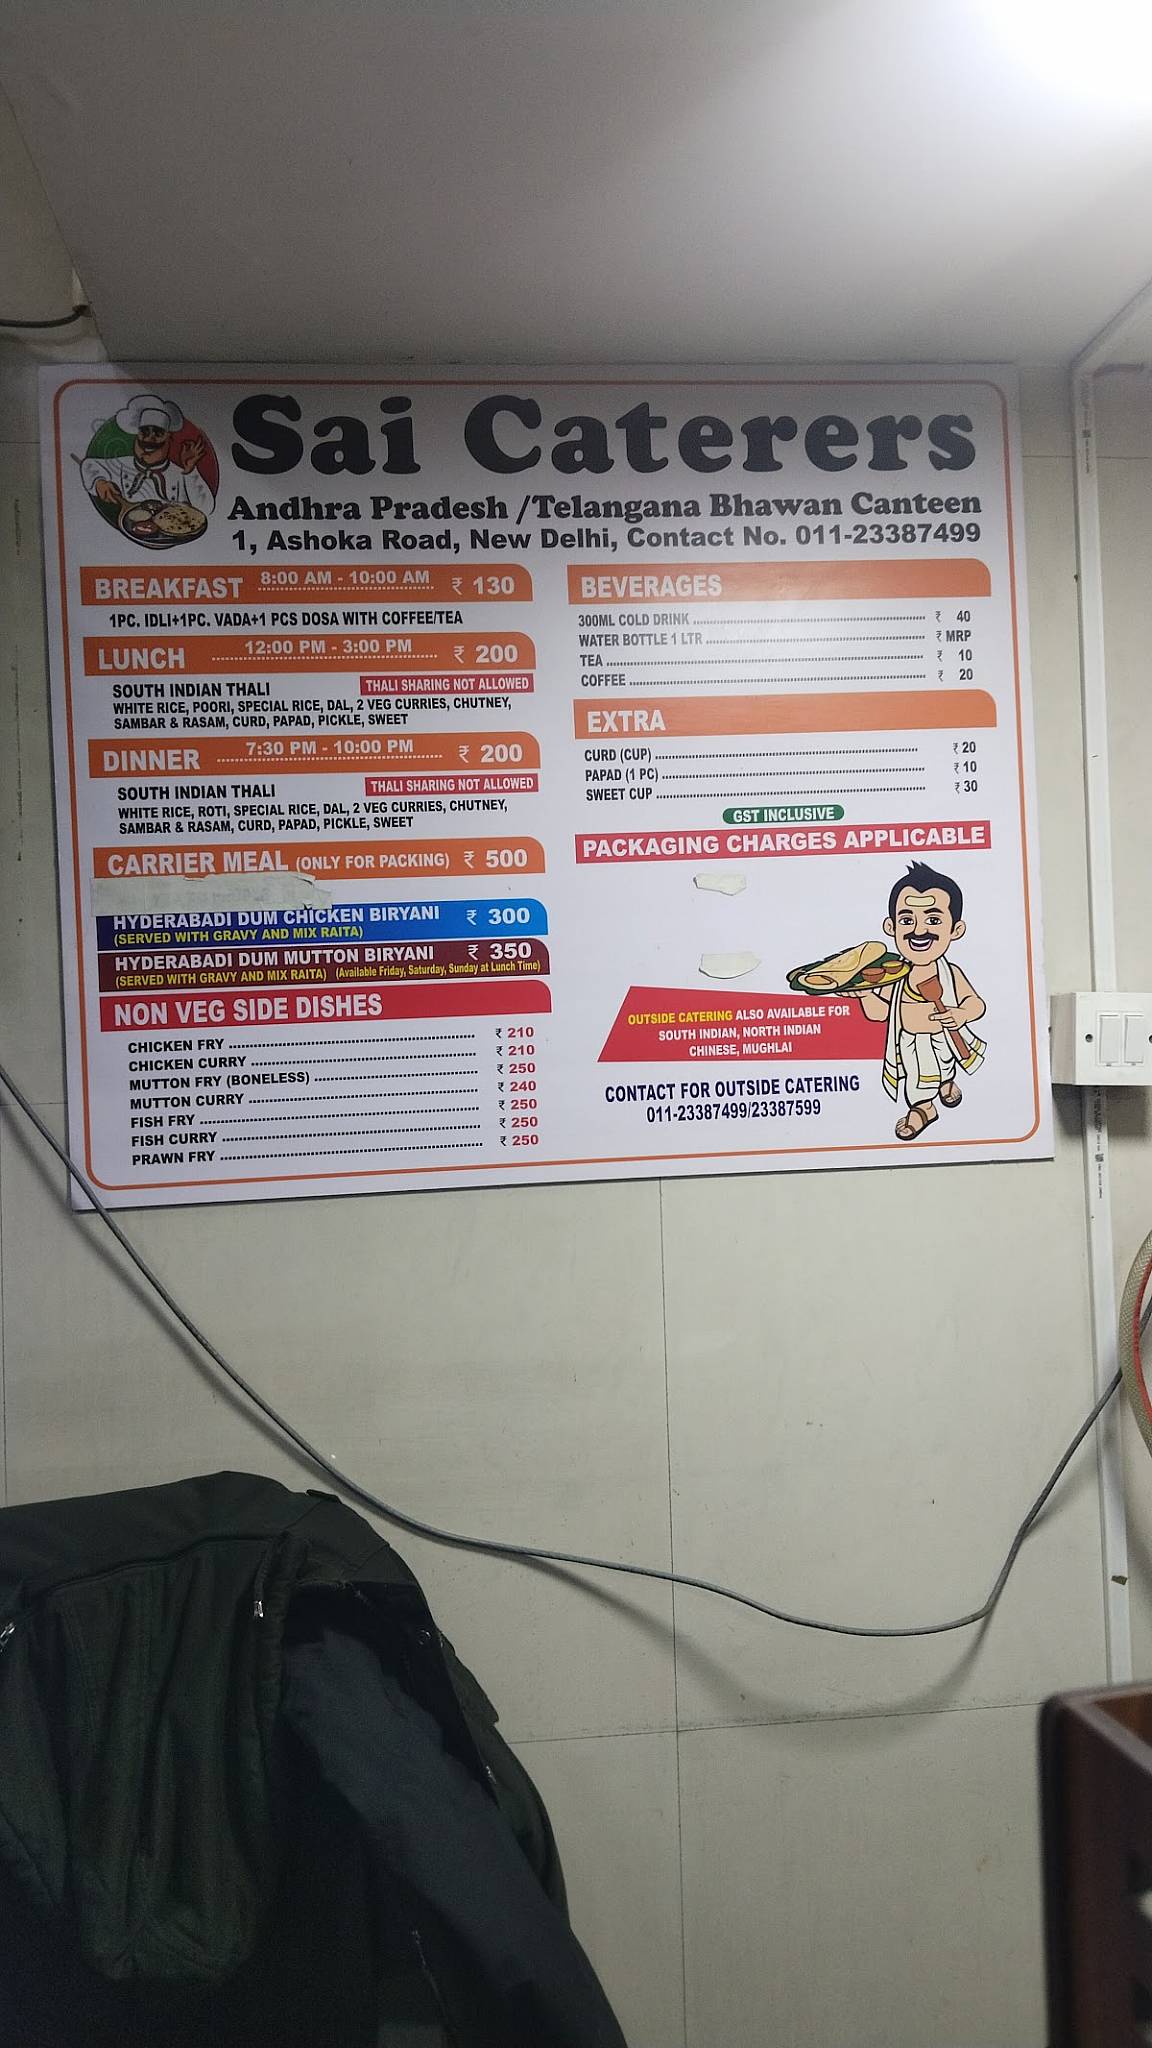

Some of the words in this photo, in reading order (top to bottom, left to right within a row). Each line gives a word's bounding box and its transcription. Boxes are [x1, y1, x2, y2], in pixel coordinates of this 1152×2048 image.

[231, 394, 421, 475] Sai
[464, 395, 976, 474] Caterers
[227, 495, 361, 520] Andhra
[370, 495, 508, 520] Pradesh
[516, 495, 701, 525] /Telangana
[709, 493, 842, 517] Bhawan
[851, 492, 982, 515] Canteen
[232, 529, 257, 555] 1,
[267, 529, 372, 551] Ashoka
[382, 529, 460, 553] Road,
[470, 529, 532, 549] New
[541, 528, 617, 552] Delhi,
[627, 526, 735, 547] Contact
[743, 526, 786, 546] No.
[796, 523, 981, 545] 011-23387499
[95, 577, 243, 599] BREAKFAST
[261, 571, 298, 584] 8:00
[304, 570, 331, 584] AM
[349, 570, 396, 584] 10:00
[402, 570, 429, 584] AM
[473, 576, 514, 594] 130
[582, 574, 722, 598] BEVERAGES
[109, 613, 140, 628] 1PC.
[144, 612, 210, 627] IDLI+1PC.
[213, 612, 265, 626] VADA+1
[270, 612, 297, 626] PCS
[301, 611, 339, 626] DOSA
[342, 611, 377, 625] WITH
[381, 610, 463, 625] COFFEE/TEA
[578, 613, 615, 627] 300ML
[618, 613, 649, 626] COLD
[653, 613, 688, 625] DRINK
[956, 610, 970, 622] 40
[578, 633, 619, 647] WATER
[622, 633, 667, 646] BOTTLE
[681, 632, 701, 644] LTR
[945, 629, 971, 642] MRP
[98, 647, 185, 670] LUNCH
[245, 640, 293, 654] 12:00
[299, 639, 325, 653] PM
[342, 639, 379, 653] 3:00
[385, 638, 412, 652] PM
[475, 644, 518, 663] 200
[579, 654, 603, 666] TEA
[958, 648, 972, 661] 10
[365, 679, 398, 691] THALI
[401, 678, 450, 691] SHARING
[453, 677, 475, 690] NOT
[478, 676, 529, 690] ALLOWED
[581, 673, 626, 687] COFFEE
[959, 668, 973, 680] 20
[112, 683, 164, 698] SOUTH
[169, 682, 221, 697] INDIAN
[225, 682, 270, 696] THALI
[112, 702, 154, 714] WHITE
[156, 701, 189, 716] RICE,
[192, 700, 234, 715] POORI,
[237, 700, 288, 712] SPECIAL
[291, 699, 323, 713] RICE,
[326, 699, 353, 713] DAL,
[366, 698, 391, 710] VEG
[395, 697, 449, 711] CURRIES,
[453, 696, 511, 710] CHUTNEY,
[113, 717, 166, 729] SAMBAR
[182, 716, 229, 730] RASAM,
[232, 715, 269, 729] CURD,
[273, 714, 314, 728] PAPAD,
[318, 714, 364, 728] PICKLE,
[368, 713, 408, 725] SWEET
[587, 709, 666, 732] EXTRA
[103, 749, 200, 771] DINNER
[245, 741, 283, 755] 7:30
[290, 740, 316, 754] PM
[333, 739, 381, 753] 10:00
[387, 738, 413, 752] PM
[480, 743, 522, 762] 200
[584, 749, 616, 761] CURD
[620, 747, 651, 763] (CUP)
[962, 741, 976, 753] 20
[585, 768, 621, 781] PAPAD
[625, 768, 634, 782] (1
[639, 767, 658, 782] PC)
[963, 760, 977, 772] 10
[586, 787, 625, 801] SWEET
[629, 787, 652, 800] CUP
[963, 779, 977, 792] 30
[733, 809, 759, 822] GST
[763, 807, 834, 822] INCLUSIVE
[583, 835, 719, 857] PACKAGING
[726, 831, 836, 852] CHARGES
[843, 826, 985, 848] APPLICABLE
[108, 852, 215, 875] CARRIER
[223, 850, 288, 873] MEAL
[295, 856, 340, 874] (ONLY
[345, 855, 375, 868] FOR
[379, 852, 449, 870] PACKING)
[485, 848, 527, 867] 500
[114, 913, 232, 932] HYDERABADI
[237, 910, 277, 925] DUM
[283, 907, 363, 924] CHICKEN
[369, 904, 441, 921] BIRYANI
[488, 907, 530, 924] 300
[114, 932, 171, 947] (SERVED
[174, 931, 208, 942] WITH
[213, 928, 257, 941] GRAVY
[261, 928, 289, 939] AND
[292, 927, 317, 938] MIX
[320, 925, 363, 939] RAITA)
[115, 952, 232, 971] HYDERABADI
[238, 951, 278, 966] DUM
[284, 948, 358, 965] MUTTON
[364, 945, 433, 962] BIRYANI
[489, 942, 531, 959] 350
[335, 966, 376, 980] (Available
[379, 965, 406, 978] Friday,
[408, 963, 446, 976] Saturday,
[448, 962, 478, 975] Sunday
[480, 962, 489, 972] at
[490, 960, 515, 971] Lunch
[517, 959, 540, 972] Time)
[114, 1002, 167, 1026] NON
[174, 999, 225, 1023] VEG
[233, 997, 288, 1021] SIDE
[296, 993, 382, 1018] DISHES
[628, 1012, 675, 1024] OUTSIDE
[678, 1010, 732, 1022] CATERING
[735, 1008, 763, 1020] ALSO
[766, 1006, 825, 1019] AVAILABLE
[828, 1005, 850, 1016] FOR
[658, 1029, 696, 1041] SOUTH
[699, 1027, 740, 1039] INDIAN,
[743, 1025, 780, 1037] NORTH
[783, 1023, 820, 1035] INDIAN
[127, 1039, 192, 1053] CHICKEN
[197, 1038, 224, 1050] FRY
[689, 1044, 739, 1056] CHINESE,
[742, 1041, 792, 1054] MUGHLAI
[128, 1058, 193, 1072] CHICKEN
[198, 1055, 246, 1068] CURRY
[129, 1077, 190, 1090] MUTTON
[195, 1075, 222, 1087] FRY
[226, 1071, 309, 1088] (BONELESS)
[509, 1062, 535, 1074] 250
[605, 1083, 676, 1104] CONTACT
[680, 1082, 710, 1099] FOR
[715, 1078, 780, 1097] OUTSIDE
[785, 1075, 859, 1094] CATERING
[646, 1099, 821, 1123] 011-23387499/23387599
[132, 1152, 183, 1165] PRAWN
[188, 1150, 215, 1162] FRY
